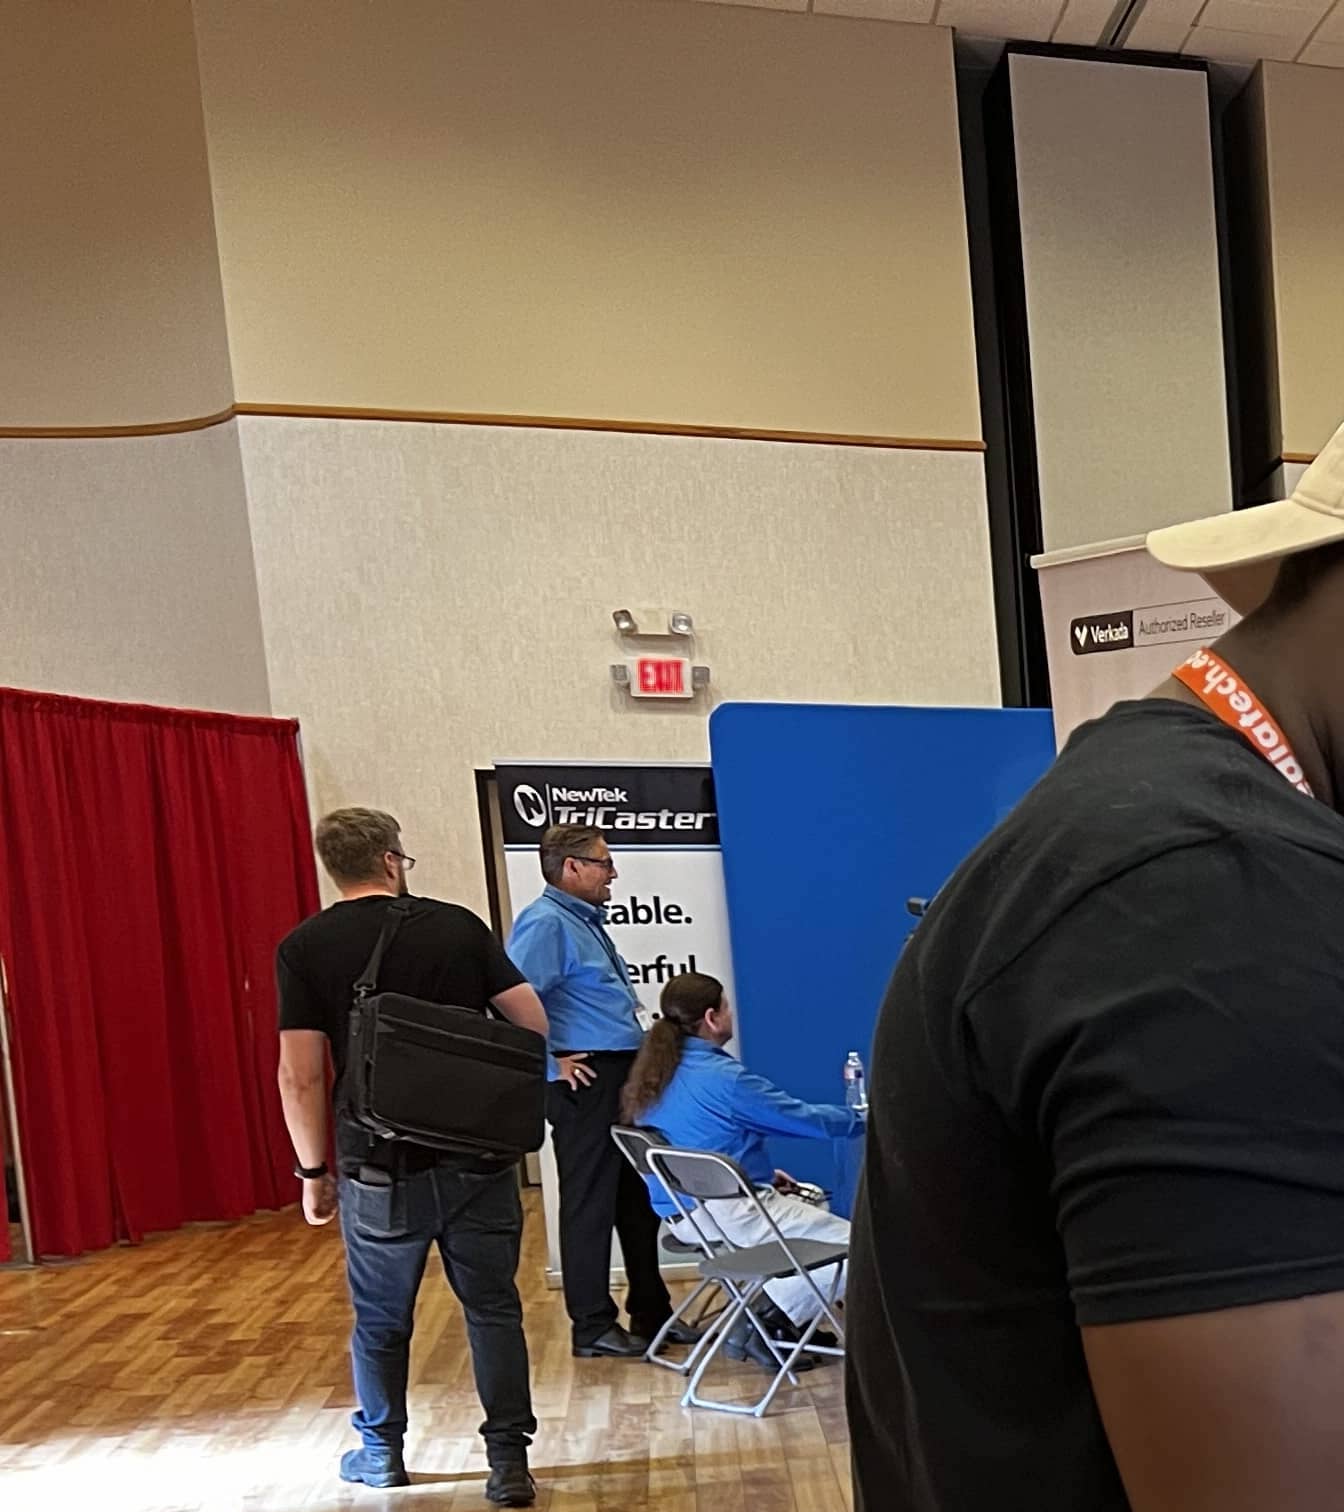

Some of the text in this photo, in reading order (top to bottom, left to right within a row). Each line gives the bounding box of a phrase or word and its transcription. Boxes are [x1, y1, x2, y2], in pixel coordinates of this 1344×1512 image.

[1090, 611, 1226, 643] Verkada Authorized Reseller
[638, 659, 684, 694] EXIT
[552, 787, 628, 802] NewTek
[554, 806, 711, 830] TriCaster
